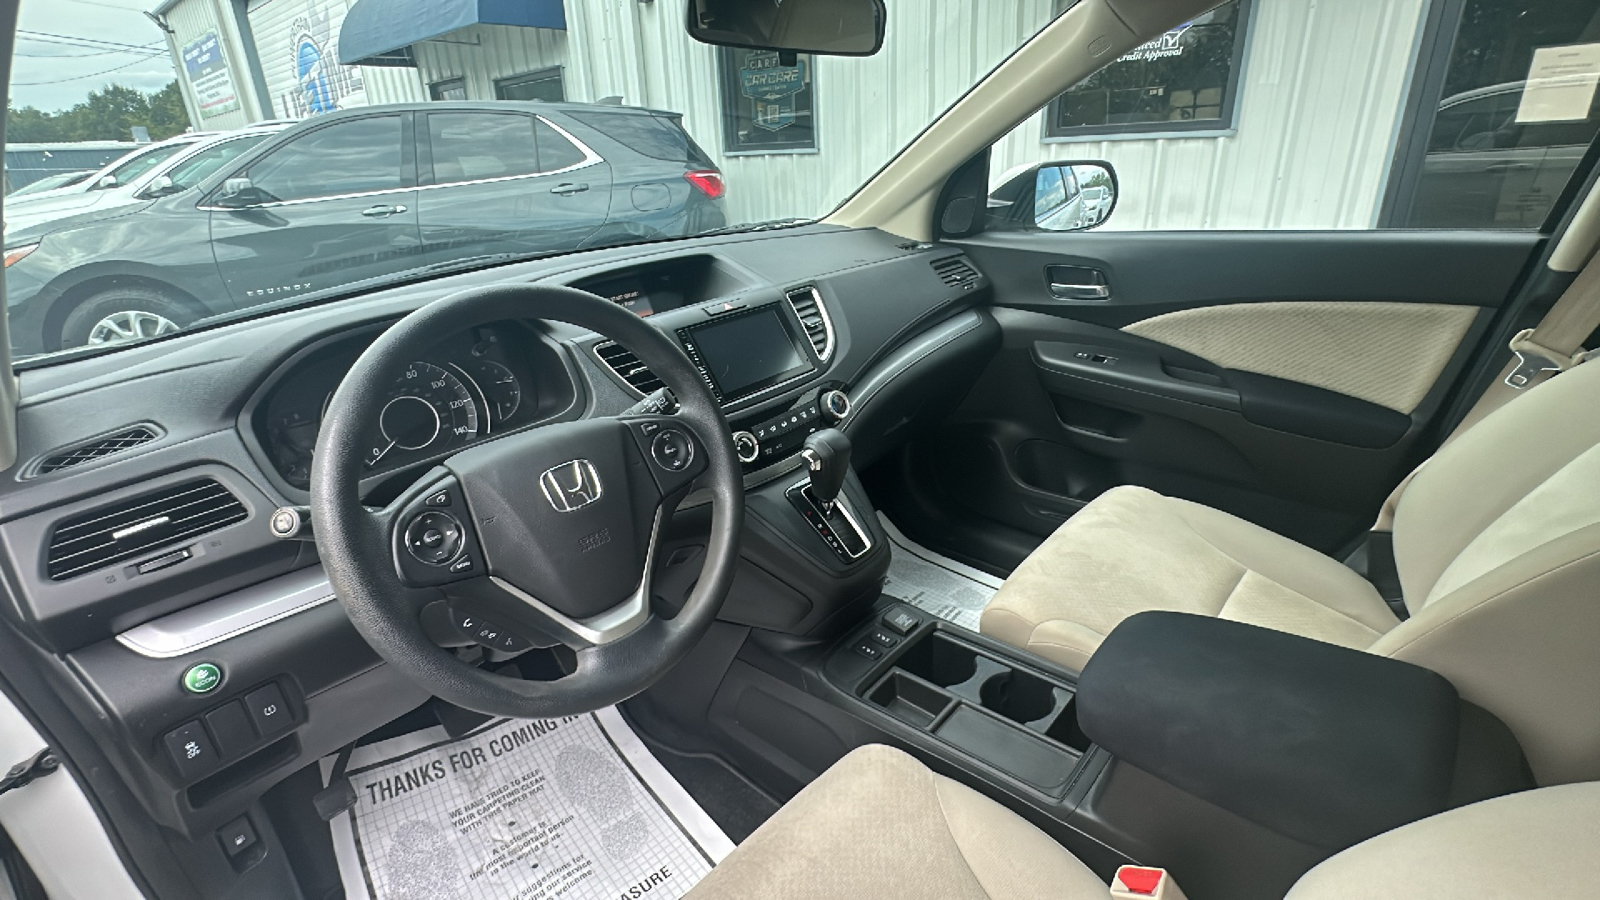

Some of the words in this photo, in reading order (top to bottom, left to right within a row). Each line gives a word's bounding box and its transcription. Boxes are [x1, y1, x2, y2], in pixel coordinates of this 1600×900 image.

[750, 58, 777, 69] CARF
[1143, 46, 1183, 62] Approval
[246, 283, 311, 297] EQUINOX
[406, 370, 417, 379] 80
[431, 379, 446, 389] 100
[449, 399, 464, 409] 120
[453, 425, 468, 435] 140
[194, 675, 216, 688] ECON
[366, 759, 446, 805] THANKS
[449, 746, 487, 773] FOR
[489, 717, 558, 758] COMING
[449, 807, 463, 819] WE
[464, 796, 486, 813] HAVE
[486, 784, 509, 801] TRIED
[510, 778, 521, 788] TO
[521, 768, 540, 781] KEEP
[452, 813, 476, 828] YOUR
[476, 788, 520, 816] CARPETING
[521, 775, 546, 791] CLEAN
[460, 820, 483, 835] WITH
[483, 808, 502, 821] THIS
[502, 793, 528, 810] PAPER
[528, 784, 545, 796] MAT
[485, 854, 507, 871] most
[547, 814, 574, 834] person
[500, 826, 538, 851] customer
[538, 821, 547, 829] is
[490, 868, 499, 877] in
[500, 857, 515, 870] the
[516, 843, 540, 862] world
[540, 838, 549, 848] to
[521, 861, 572, 897] suggestions
[572, 853, 585, 865] for
[546, 878, 561, 891] our
[561, 859, 593, 881] service
[621, 864, 673, 900] ASURE
